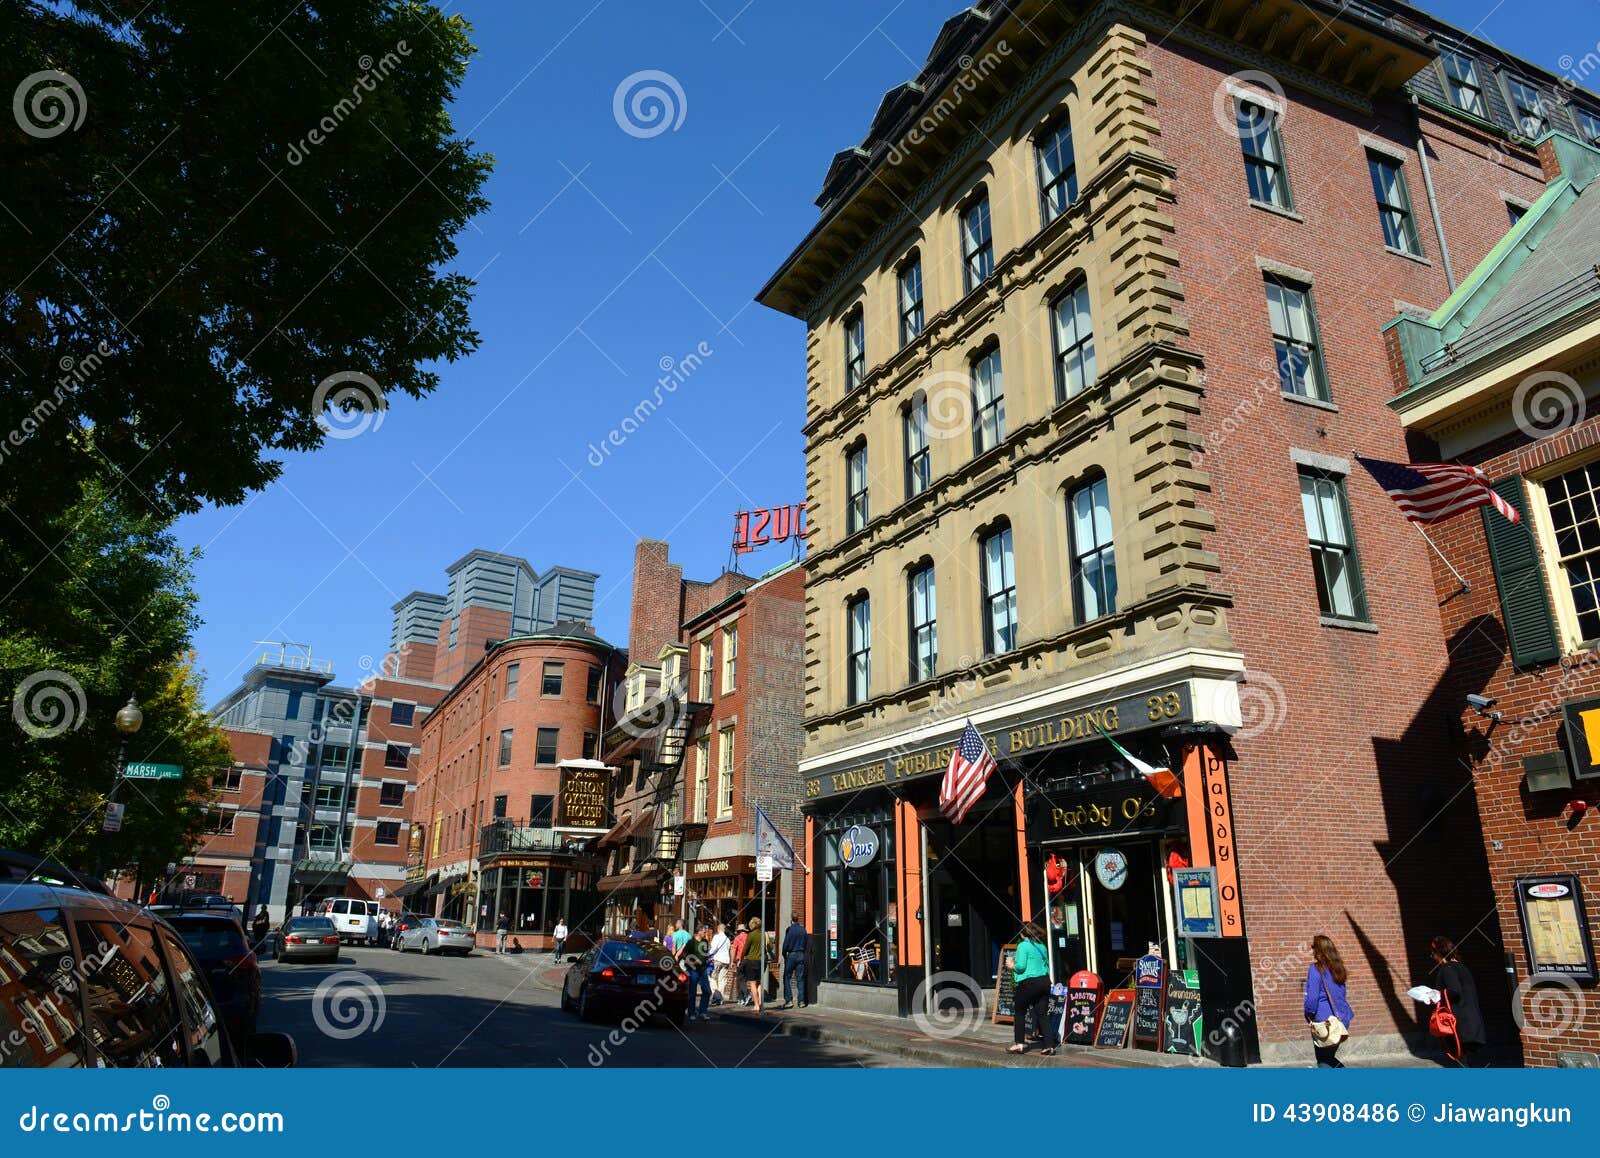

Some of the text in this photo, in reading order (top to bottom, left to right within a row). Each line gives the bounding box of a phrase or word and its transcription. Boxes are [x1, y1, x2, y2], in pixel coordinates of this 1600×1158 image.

[806, 778, 821, 798] 33
[831, 763, 887, 793] YANKEE
[1009, 704, 1120, 754] BUILDING
[1147, 691, 1181, 722] 33
[126, 764, 157, 777] MARSH
[567, 780, 605, 794] UNION
[564, 792, 605, 806] OYSTER
[566, 805, 602, 818] HOUSE
[1051, 797, 1156, 828] Paddy O's
[847, 824, 874, 864] Saus
[694, 859, 729, 874] UNION GOODS
[1139, 959, 1159, 971] SAMUEL
[1070, 991, 1097, 1003] LOBSTER
